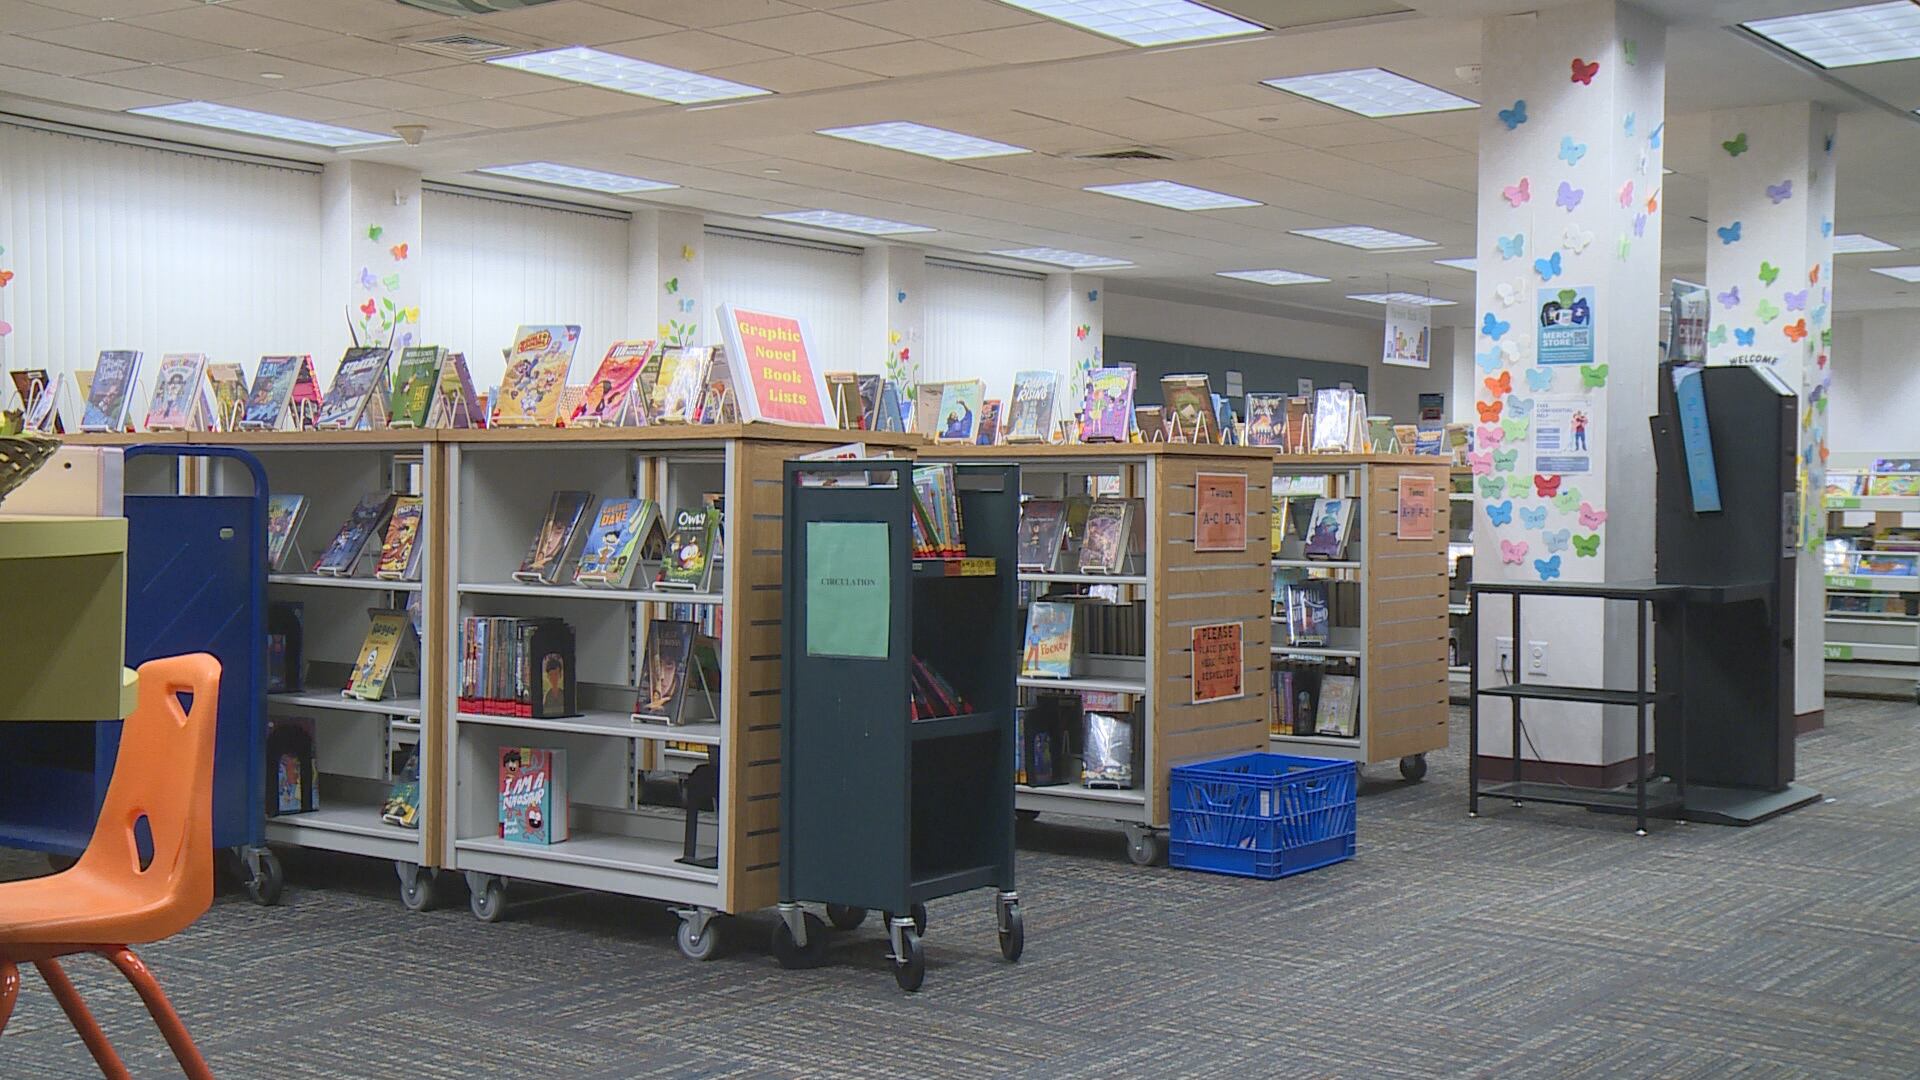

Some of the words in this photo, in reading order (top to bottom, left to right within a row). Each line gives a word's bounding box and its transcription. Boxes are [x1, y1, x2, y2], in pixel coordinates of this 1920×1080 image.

[740, 321, 801, 342] Graphic
[1542, 331, 1574, 340] MERCH
[1542, 339, 1572, 347] STORE
[756, 346, 797, 363] Novel
[1729, 354, 1780, 366] WELCOME
[763, 367, 802, 384] Book
[769, 389, 807, 406] Lists
[1017, 387, 1047, 402] RISING
[1210, 487, 1233, 498] Tween
[601, 511, 628, 527] DAVE
[1203, 512, 1219, 525] A-C
[1225, 512, 1241, 525] D-K
[821, 577, 876, 587] CIRCULATION
[1831, 576, 1856, 587] NEW
[1202, 626, 1233, 640] PLEASE
[503, 778, 513, 796] I
[533, 771, 545, 790] A
[503, 788, 545, 811] DINOSAUR
